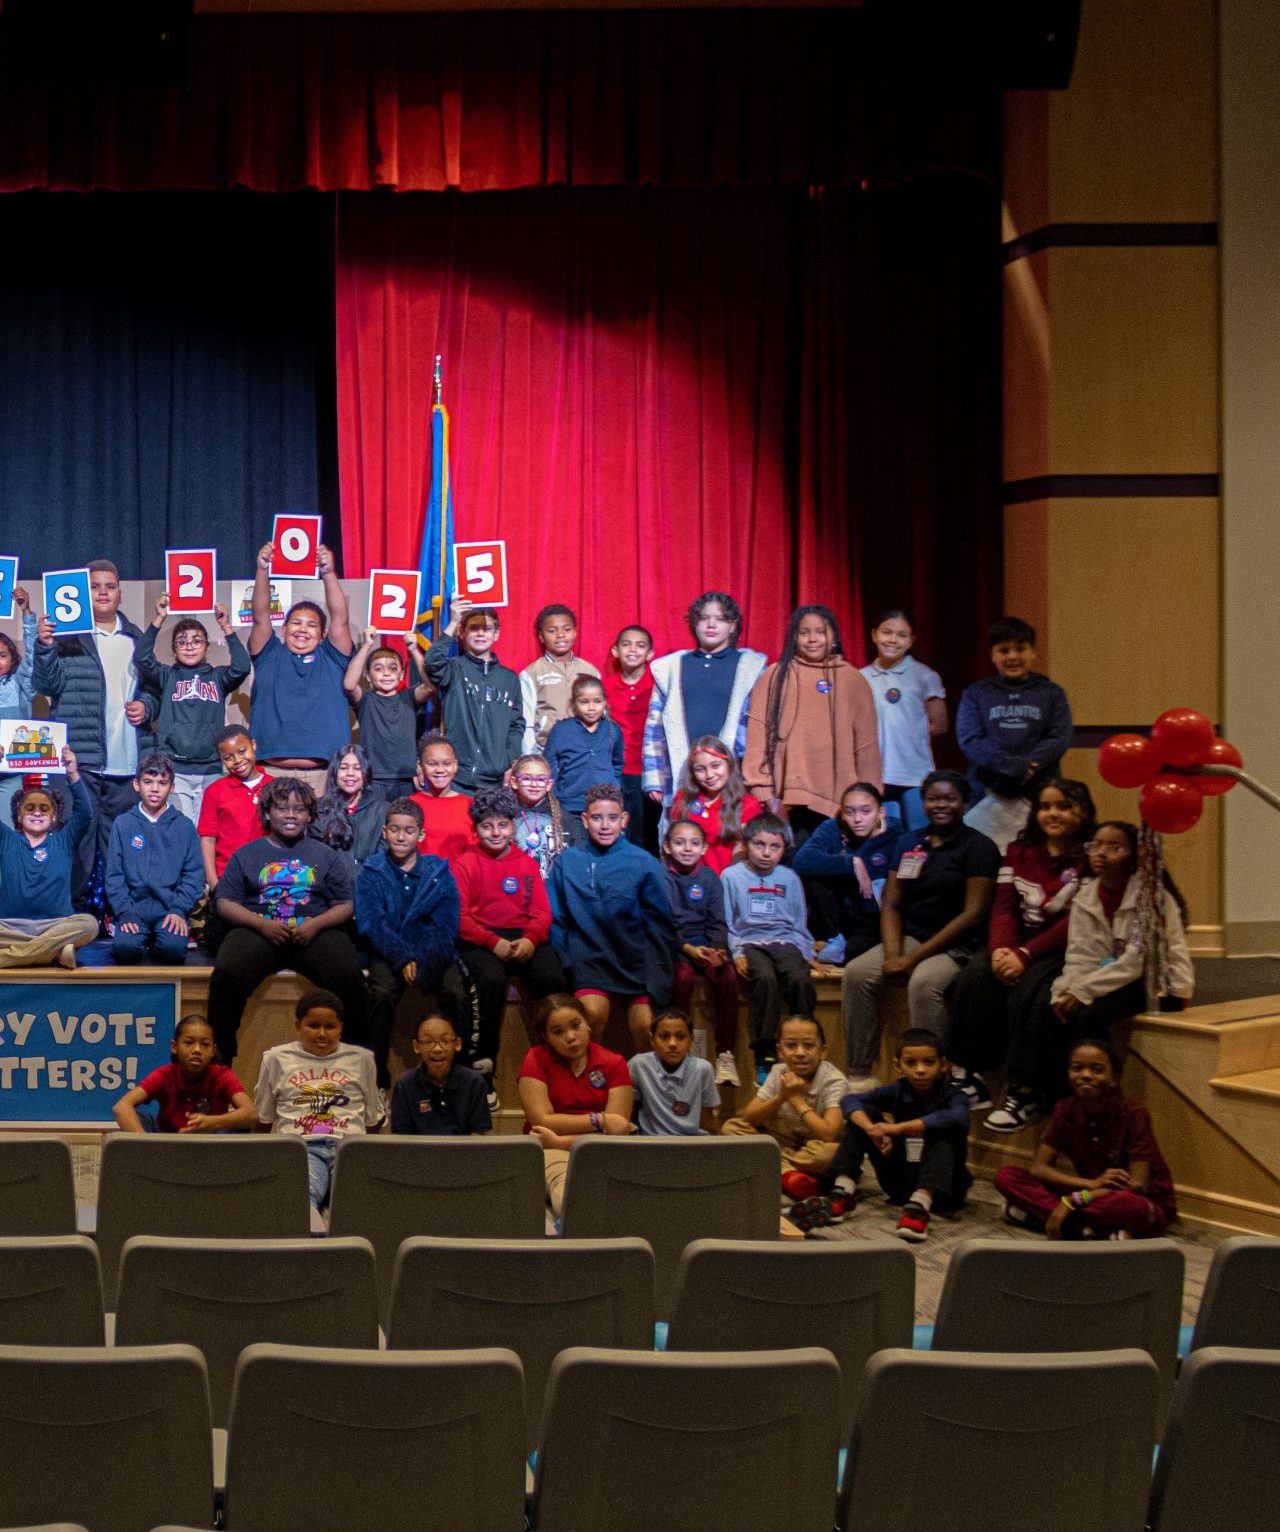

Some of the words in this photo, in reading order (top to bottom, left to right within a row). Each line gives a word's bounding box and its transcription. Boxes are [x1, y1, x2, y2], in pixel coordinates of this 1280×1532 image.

[280, 527, 310, 562] 0
[178, 564, 204, 598] 2
[465, 552, 495, 593] 5
[54, 585, 82, 623] S
[380, 583, 407, 619] 2
[25, 758, 58, 766] GOVERNOR
[47, 1010, 156, 1046] VOTE
[288, 1067, 351, 1088] PALACE
